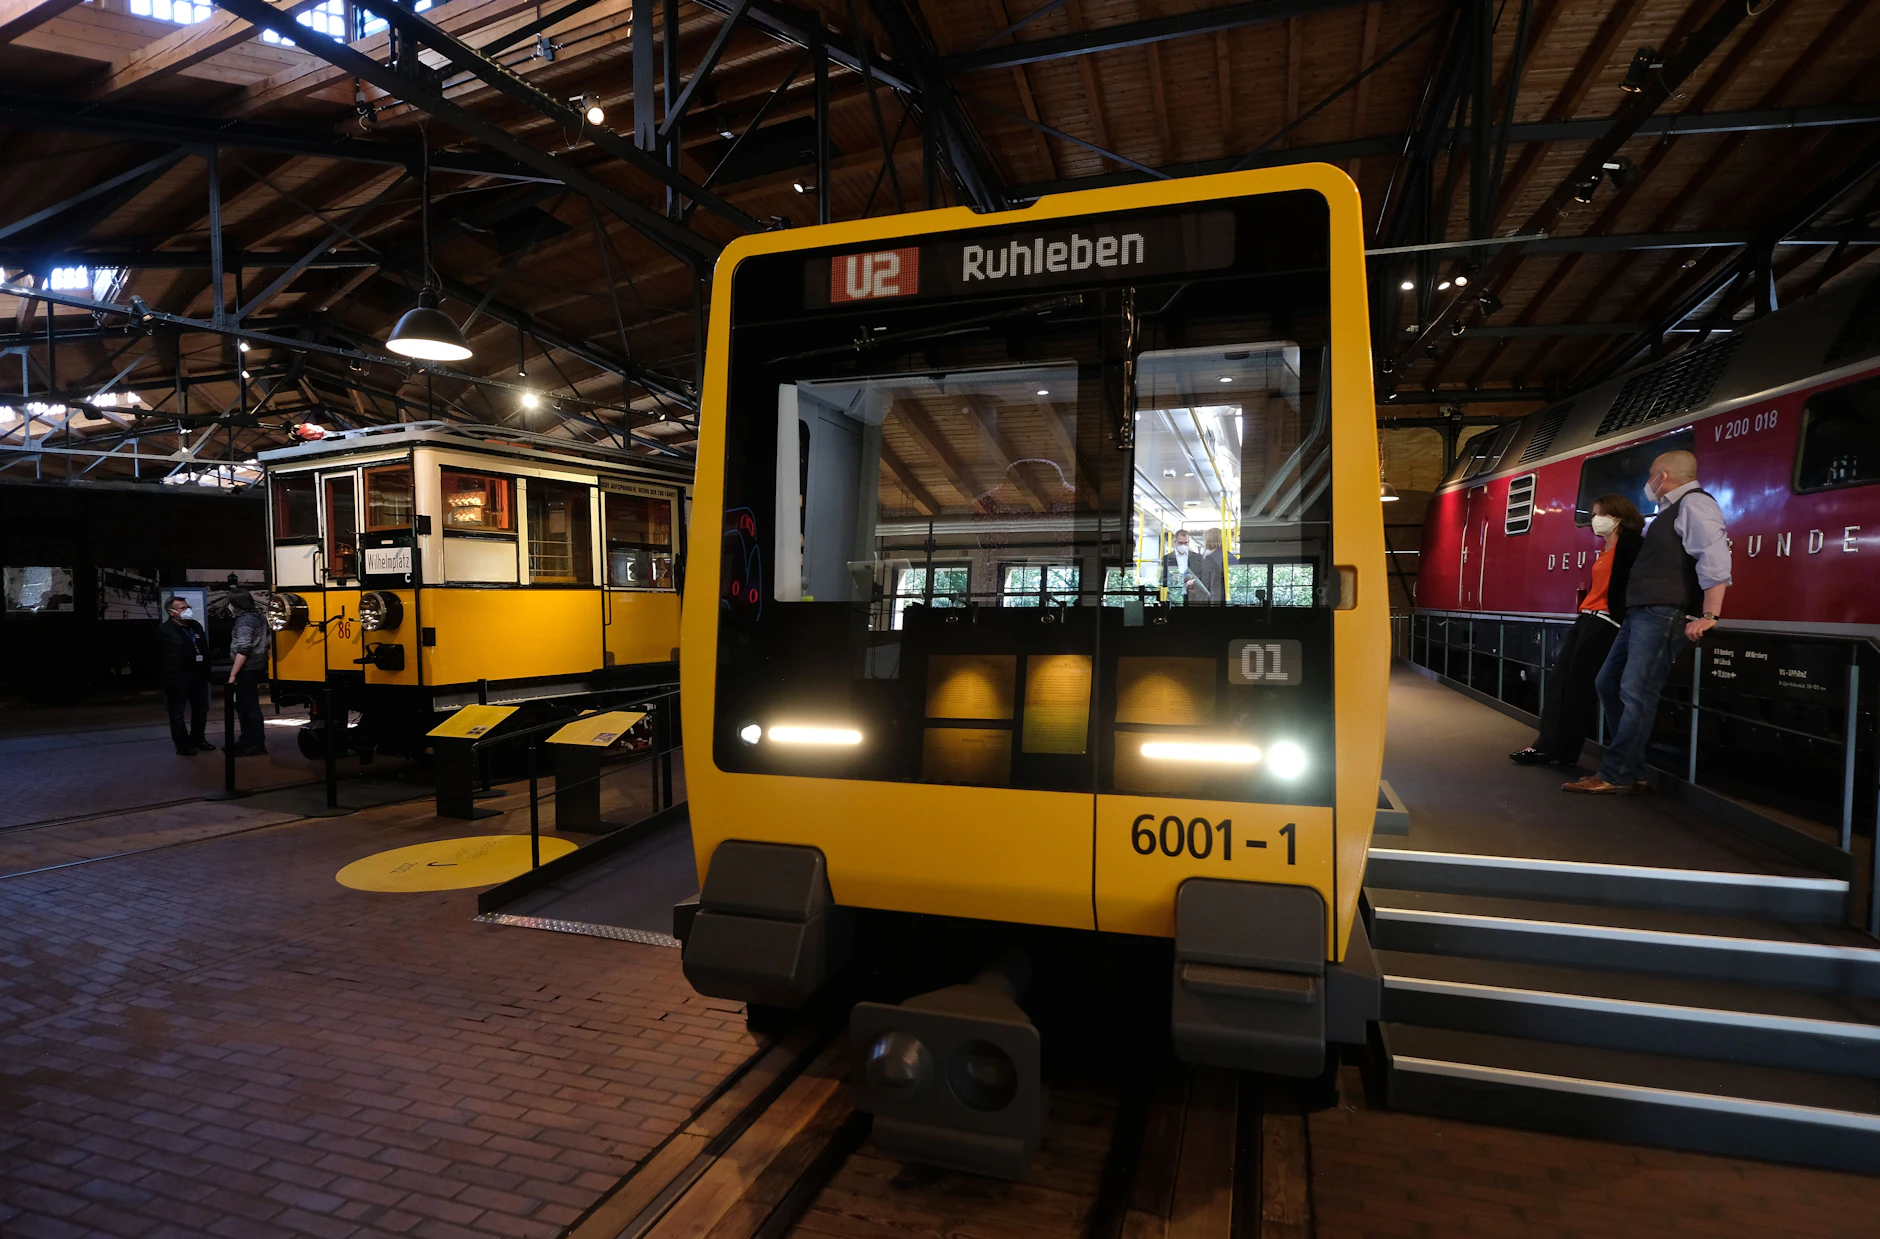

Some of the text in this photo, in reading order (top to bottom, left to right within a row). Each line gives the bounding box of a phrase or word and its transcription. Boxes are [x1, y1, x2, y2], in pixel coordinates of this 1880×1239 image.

[962, 232, 1145, 282] Ruhleben
[846, 252, 899, 298] U2
[1714, 409, 1779, 442] V 200 018
[367, 552, 410, 572] Wilhelmplatz
[1548, 549, 1602, 571] DEUT
[404, 573, 411, 583] C
[338, 621, 350, 639] 86
[1241, 643, 1289, 681] 01
